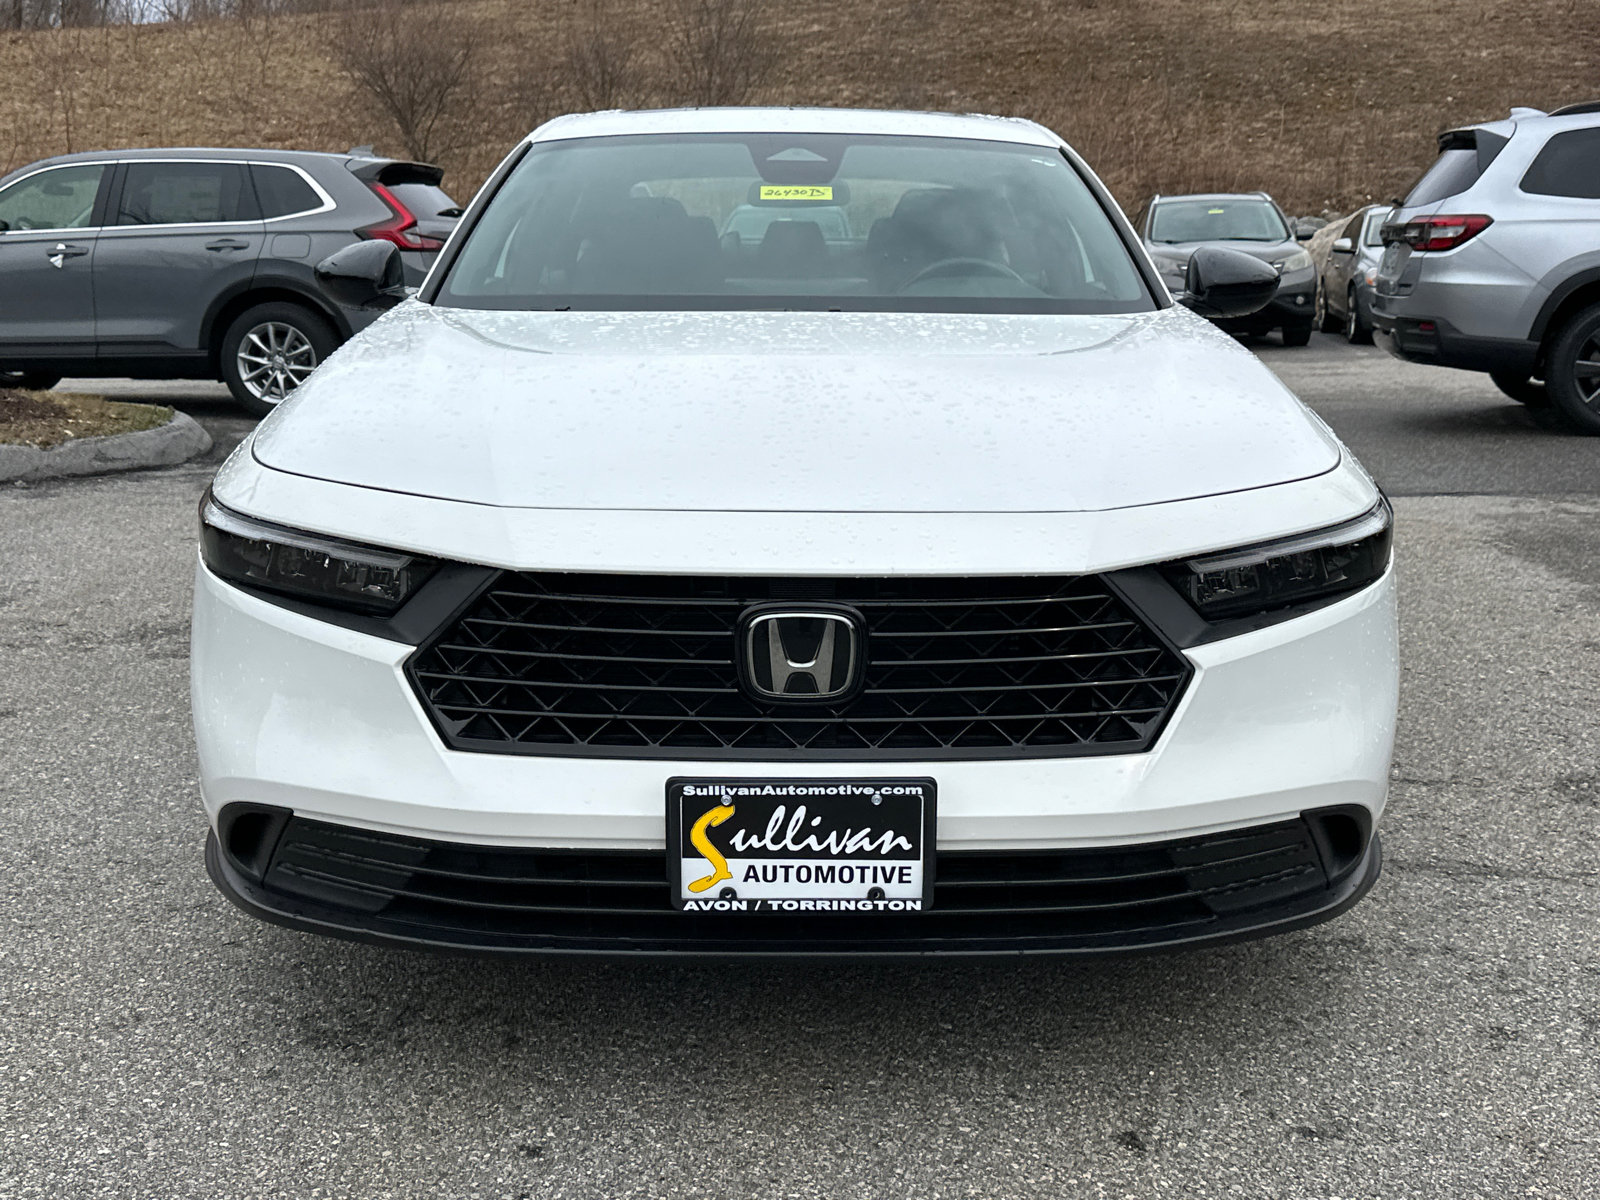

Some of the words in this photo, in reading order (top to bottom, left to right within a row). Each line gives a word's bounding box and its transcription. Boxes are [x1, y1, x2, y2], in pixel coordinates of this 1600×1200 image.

[682, 785, 923, 796] SullivanAutomotive.com
[688, 804, 913, 893] Sullivan
[742, 864, 912, 884] AUTOMOTIVE
[683, 900, 748, 911] AVON
[767, 900, 922, 911] TORRINGTON
